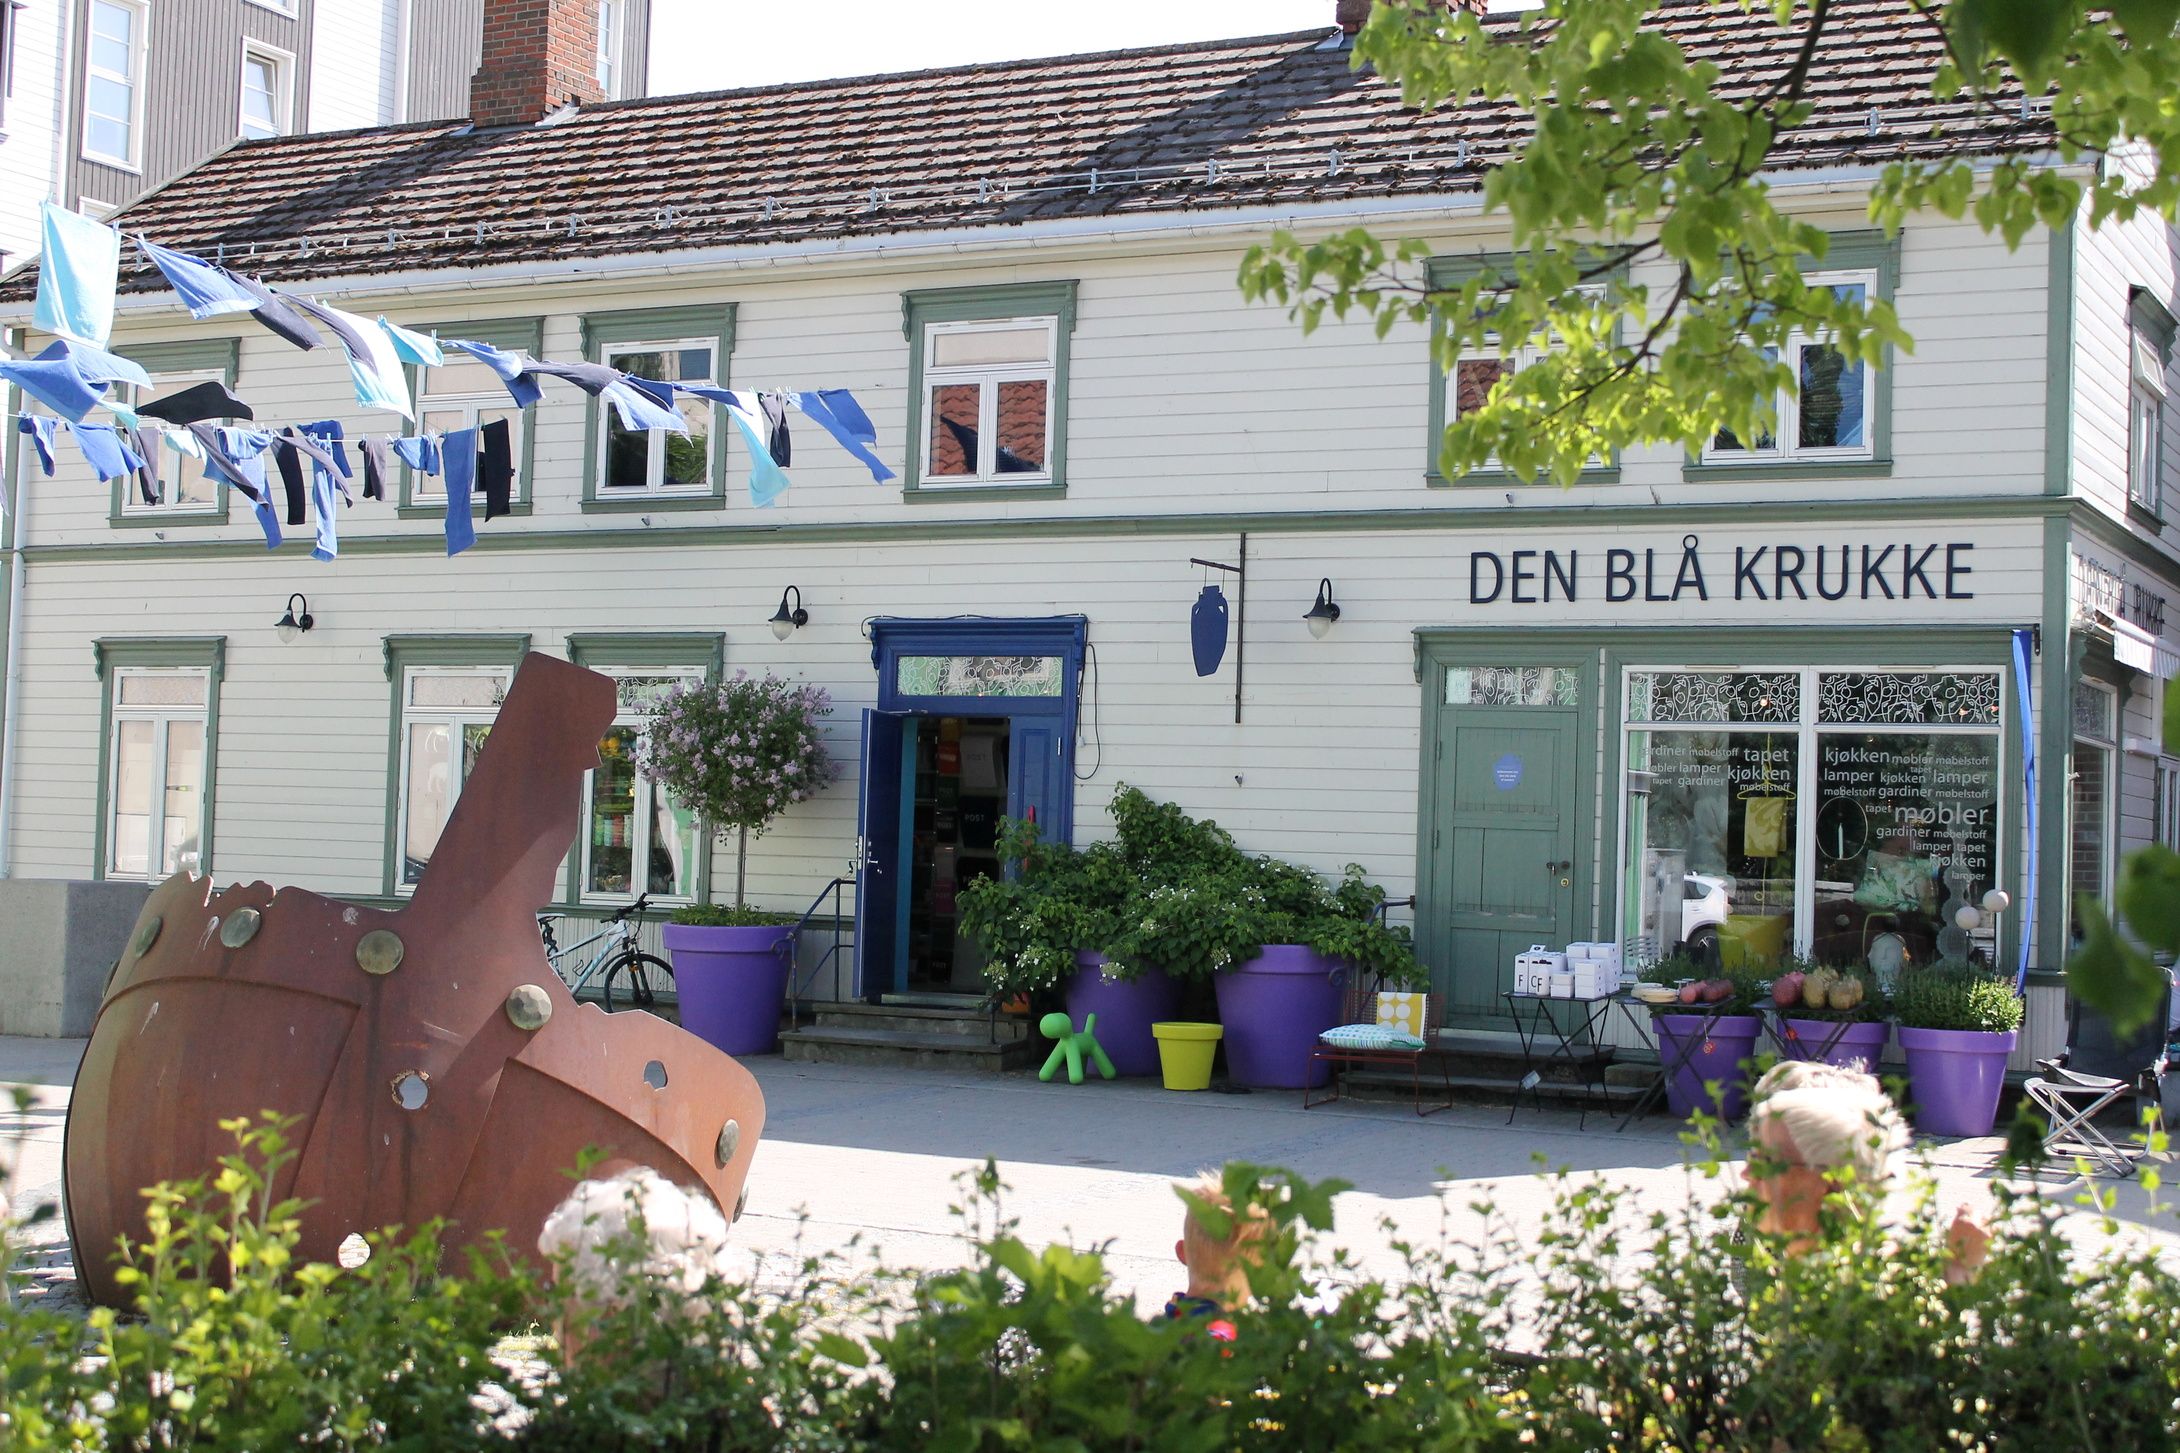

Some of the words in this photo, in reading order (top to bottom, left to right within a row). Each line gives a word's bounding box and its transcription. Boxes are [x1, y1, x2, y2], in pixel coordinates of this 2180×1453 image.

[1469, 548, 1577, 604] DEN
[1605, 534, 1709, 602] BLÅ
[1734, 543, 1975, 601] KRUKKE
[1688, 747, 1740, 757] møbelstoff
[1743, 748, 1790, 765] tapet
[1825, 746, 1890, 766] kjøkken
[1891, 753, 1934, 764] møbler
[1935, 756, 1991, 766] møbelstoff
[1679, 762, 1722, 775] lamper
[1727, 765, 1791, 784] kjøkken
[1824, 768, 1875, 784] lamper
[1880, 772, 1927, 786] kjøkken
[1933, 769, 1988, 787] lamper
[1910, 766, 1932, 775] tapet
[1652, 778, 1673, 786] tapet
[1677, 775, 1727, 788] gardiner
[1739, 782, 1791, 792] møbelstoff
[1823, 787, 1876, 797] møbelstoff
[1878, 785, 1934, 799] gardiner
[1935, 788, 1991, 799] møbelstoff
[1865, 804, 1892, 815] tapet
[1894, 801, 1989, 826] møbler
[1876, 825, 1931, 839] gardiner
[1933, 829, 1988, 840] møbelstoff
[1912, 841, 1952, 853] lamper
[1956, 843, 1986, 854] tapet
[1929, 853, 1986, 870] kjøkken
[1538, 978, 1542, 992] F
